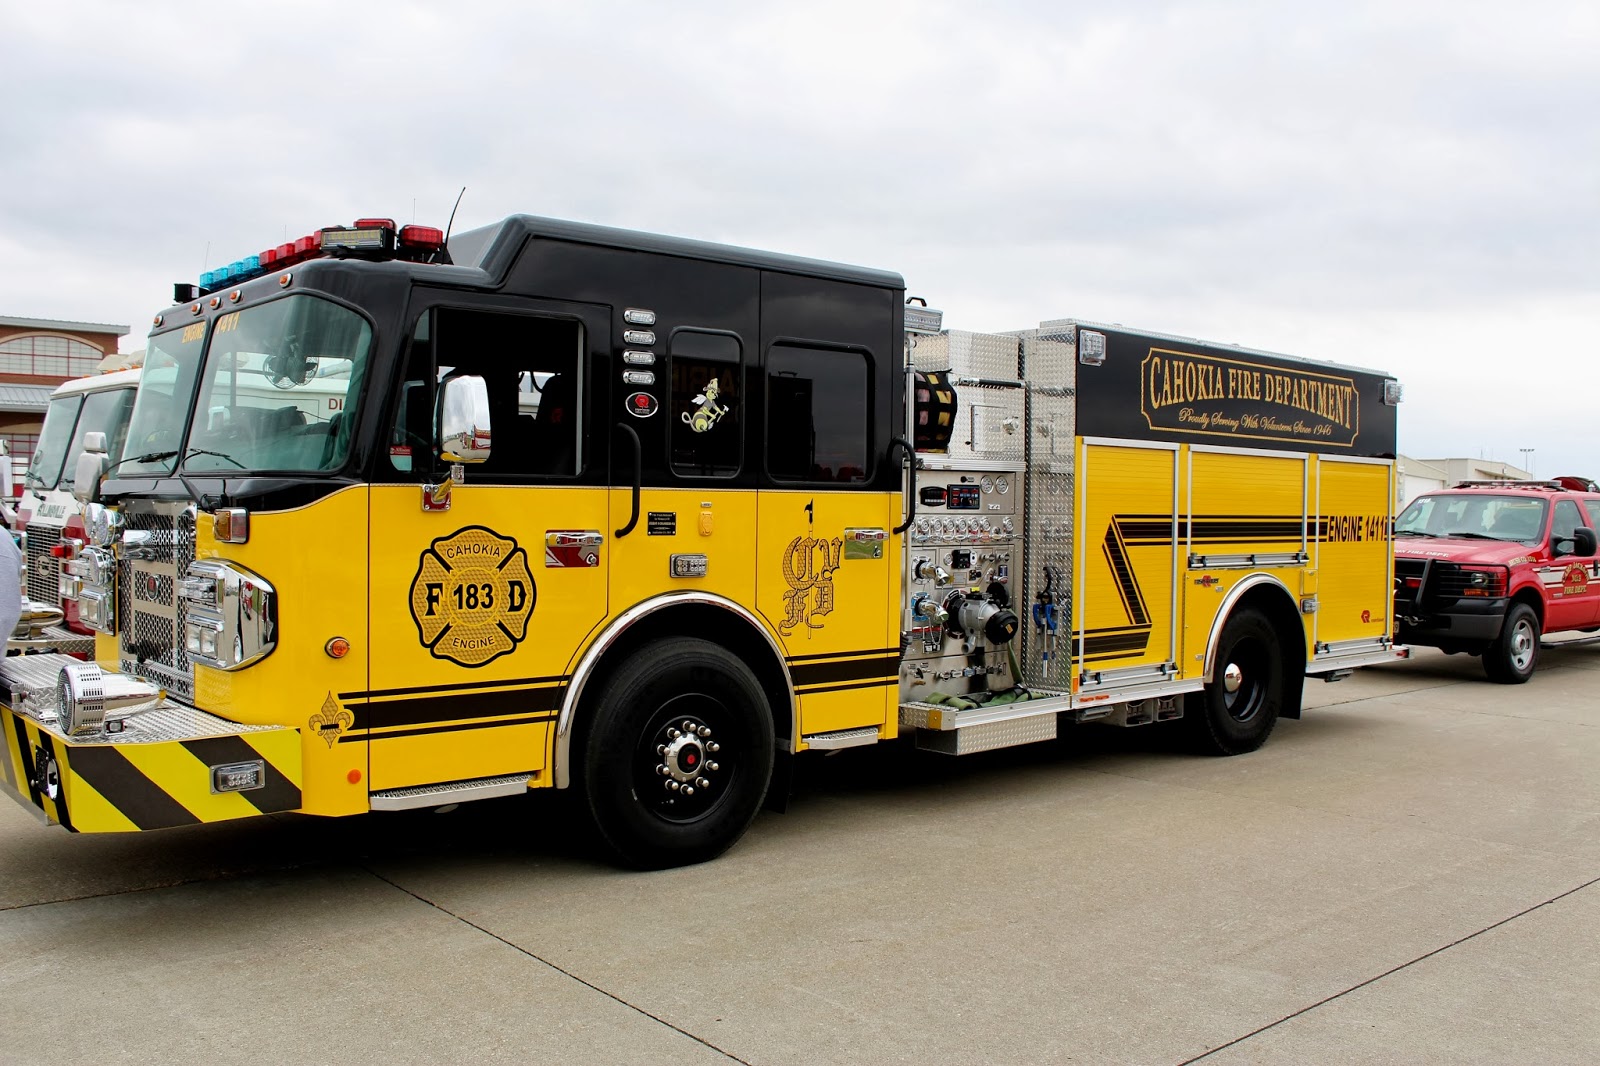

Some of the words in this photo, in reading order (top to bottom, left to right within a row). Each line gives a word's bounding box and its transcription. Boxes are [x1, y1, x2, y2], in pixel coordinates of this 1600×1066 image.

[216, 311, 240, 334] 1411
[1149, 356, 1225, 409] CAHOKIA
[1228, 368, 1261, 400] FIRE
[1265, 373, 1352, 430] DEPARTMENT
[1178, 407, 1211, 429] Proudly
[1211, 411, 1240, 432] Serving
[1240, 413, 1260, 429] With
[1293, 420, 1312, 435] Since
[1313, 424, 1333, 436] 1946
[1328, 515, 1362, 542] ENGINE
[1365, 516, 1385, 541] 1411
[446, 543, 501, 559] CAHOKIA
[424, 582, 444, 616] F
[453, 583, 494, 610] 183
[507, 580, 528, 613] D
[452, 635, 496, 649] ENGINE
